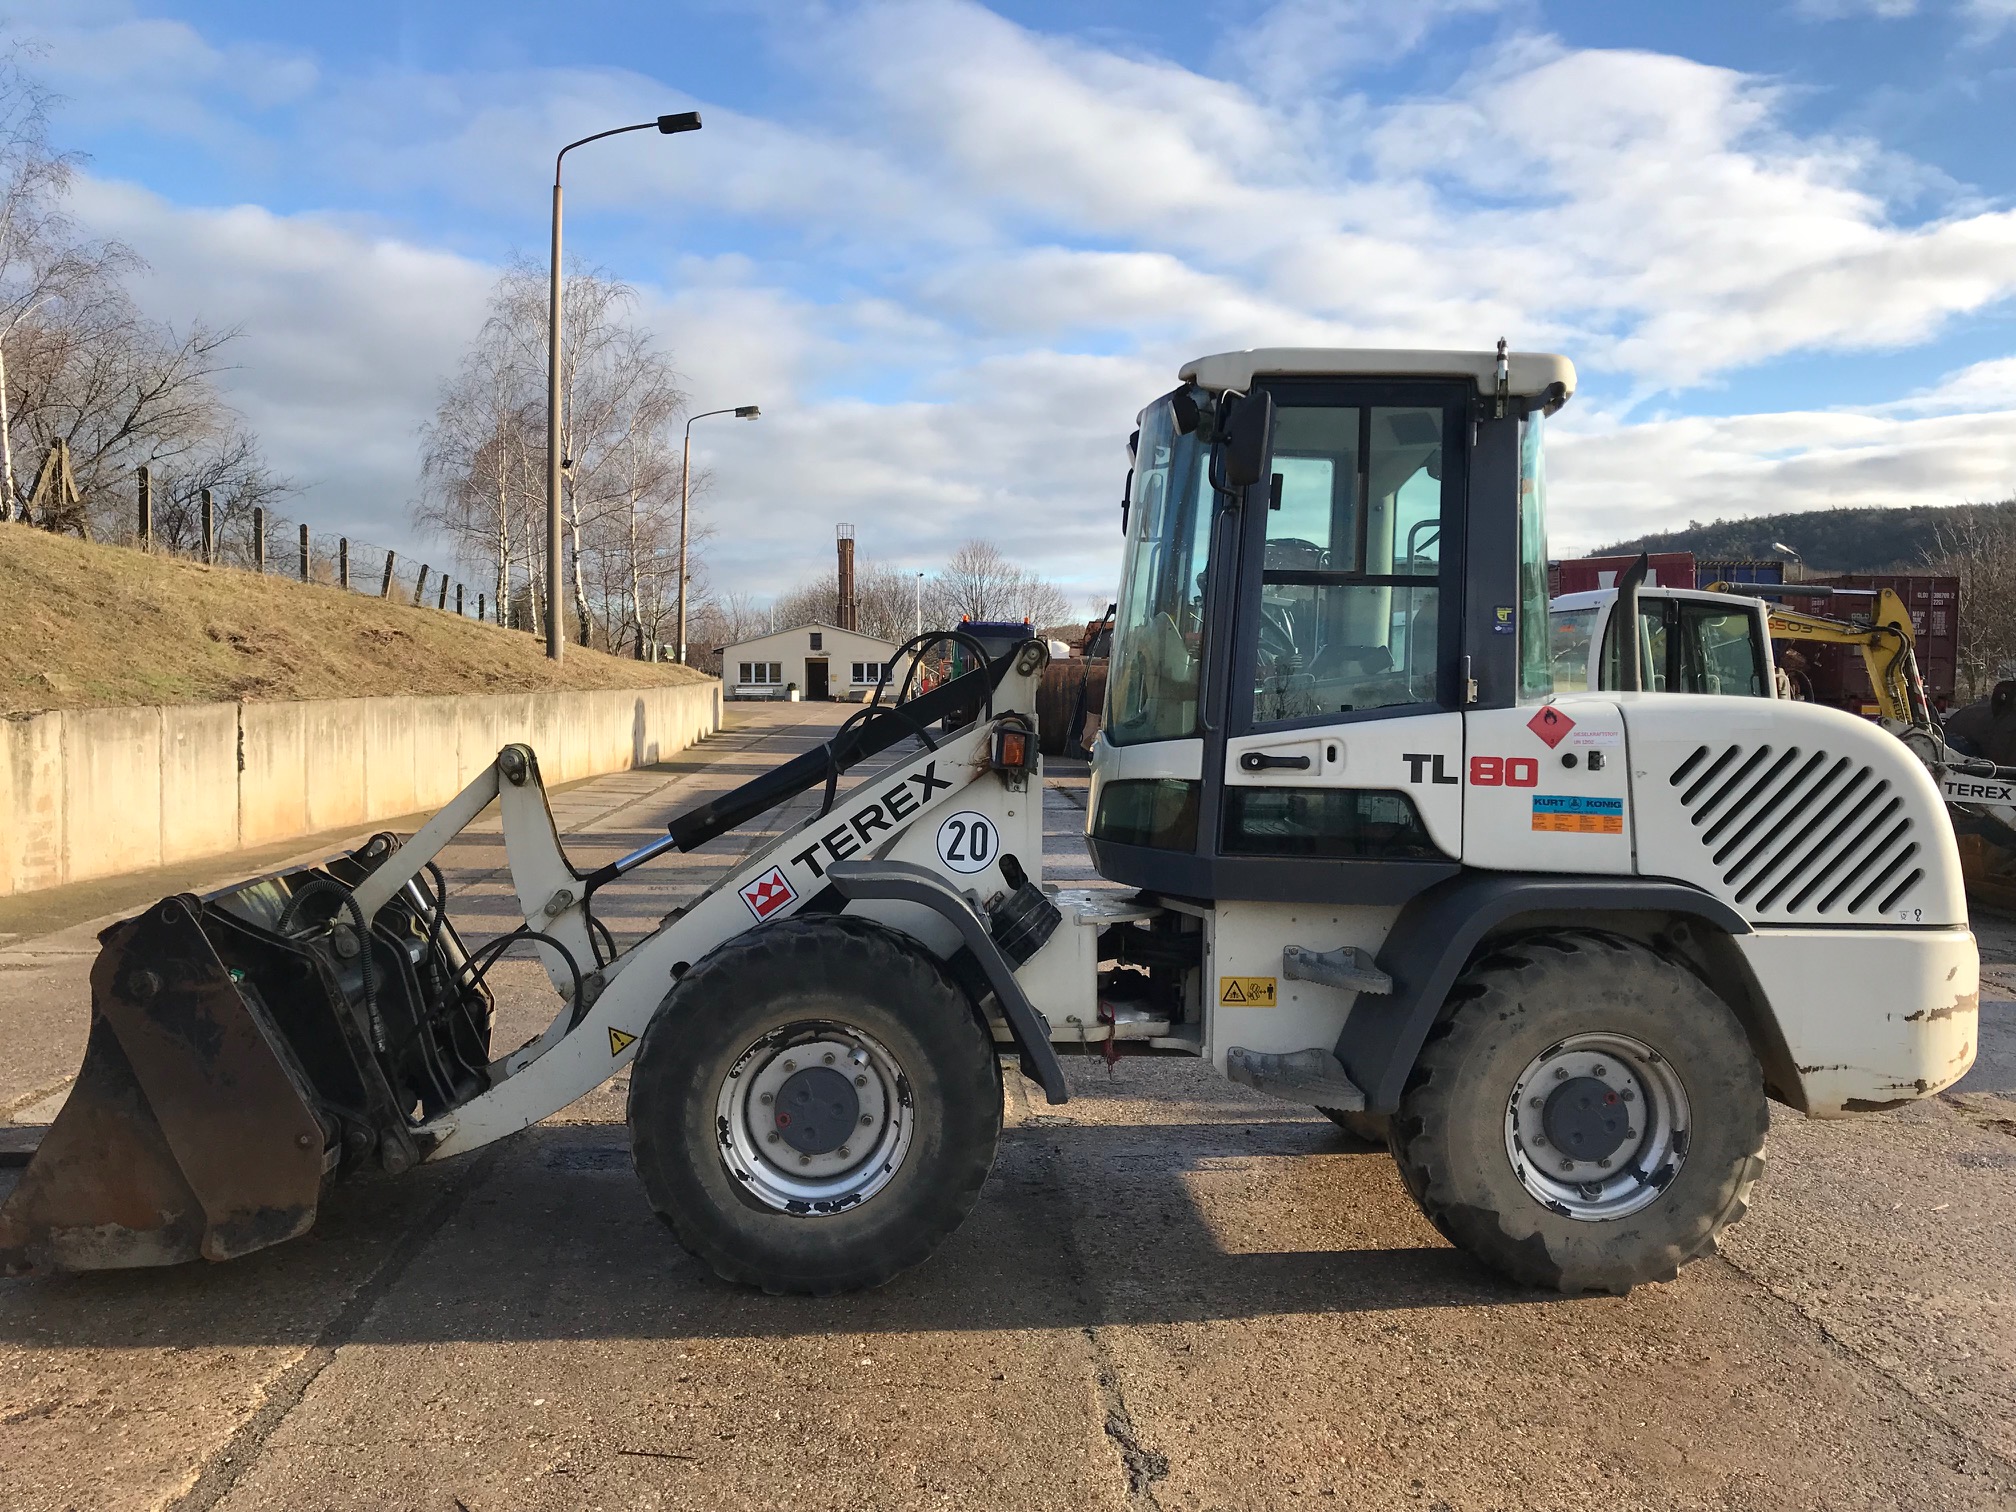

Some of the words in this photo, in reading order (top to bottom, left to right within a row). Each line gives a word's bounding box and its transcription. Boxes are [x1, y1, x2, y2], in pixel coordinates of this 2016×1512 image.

[1402, 753, 1459, 784] TL
[1470, 756, 1538, 788] 80
[1533, 798, 1566, 806] KURT
[1944, 781, 2012, 801] TEREX
[791, 760, 953, 879] TEREX
[946, 820, 989, 862] 20
